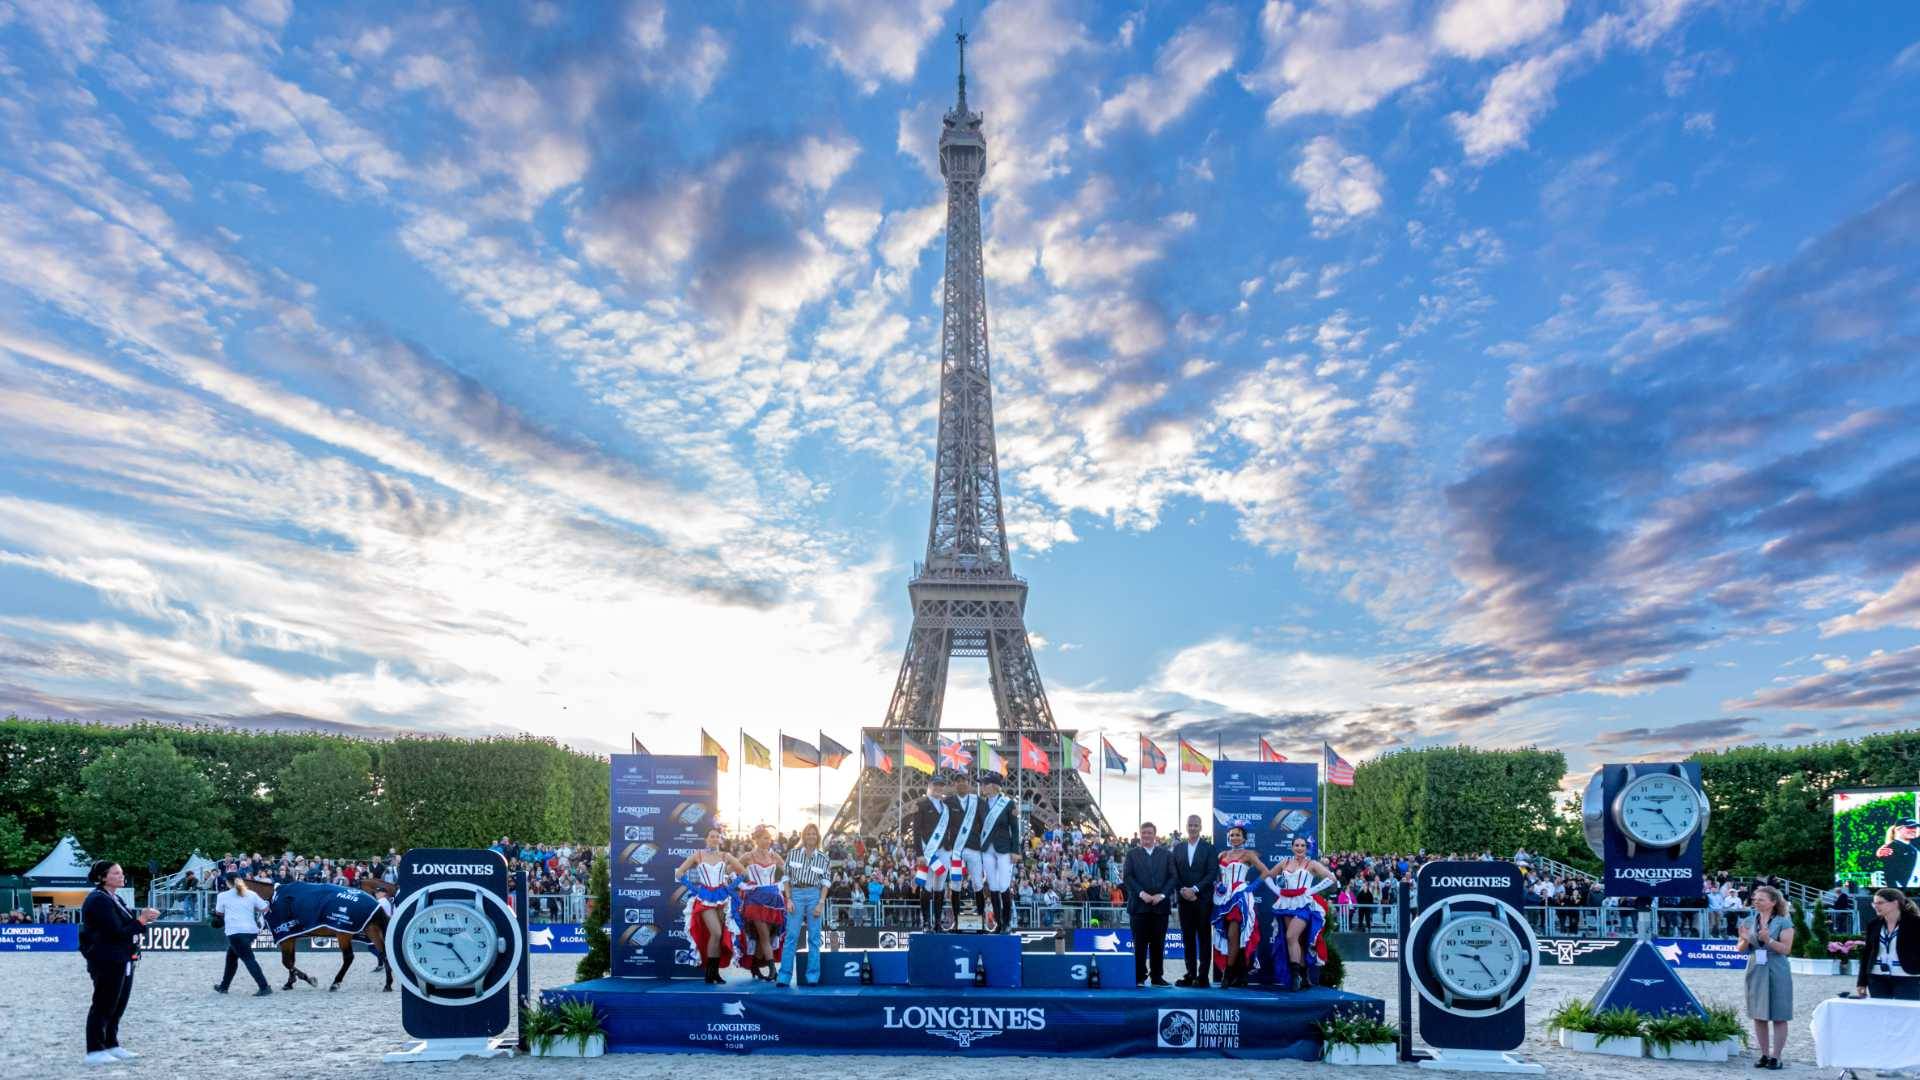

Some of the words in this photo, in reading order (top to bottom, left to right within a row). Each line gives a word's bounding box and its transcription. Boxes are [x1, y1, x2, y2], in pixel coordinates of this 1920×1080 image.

[412, 864, 494, 875] LONGINES
[1614, 868, 1693, 879] LONGINES
[1431, 877, 1511, 888] LONGINES
[1, 927, 45, 935] LONGINES
[844, 961, 860, 977] 2
[954, 957, 976, 979] 1
[1070, 964, 1088, 980] 3
[883, 1006, 1046, 1030] LONGINES
[1200, 1009, 1240, 1021] LONGINES
[707, 1023, 760, 1032] LONGINES
[689, 1033, 723, 1041] GLOBAL
[1199, 1036, 1239, 1048] JUMPING
